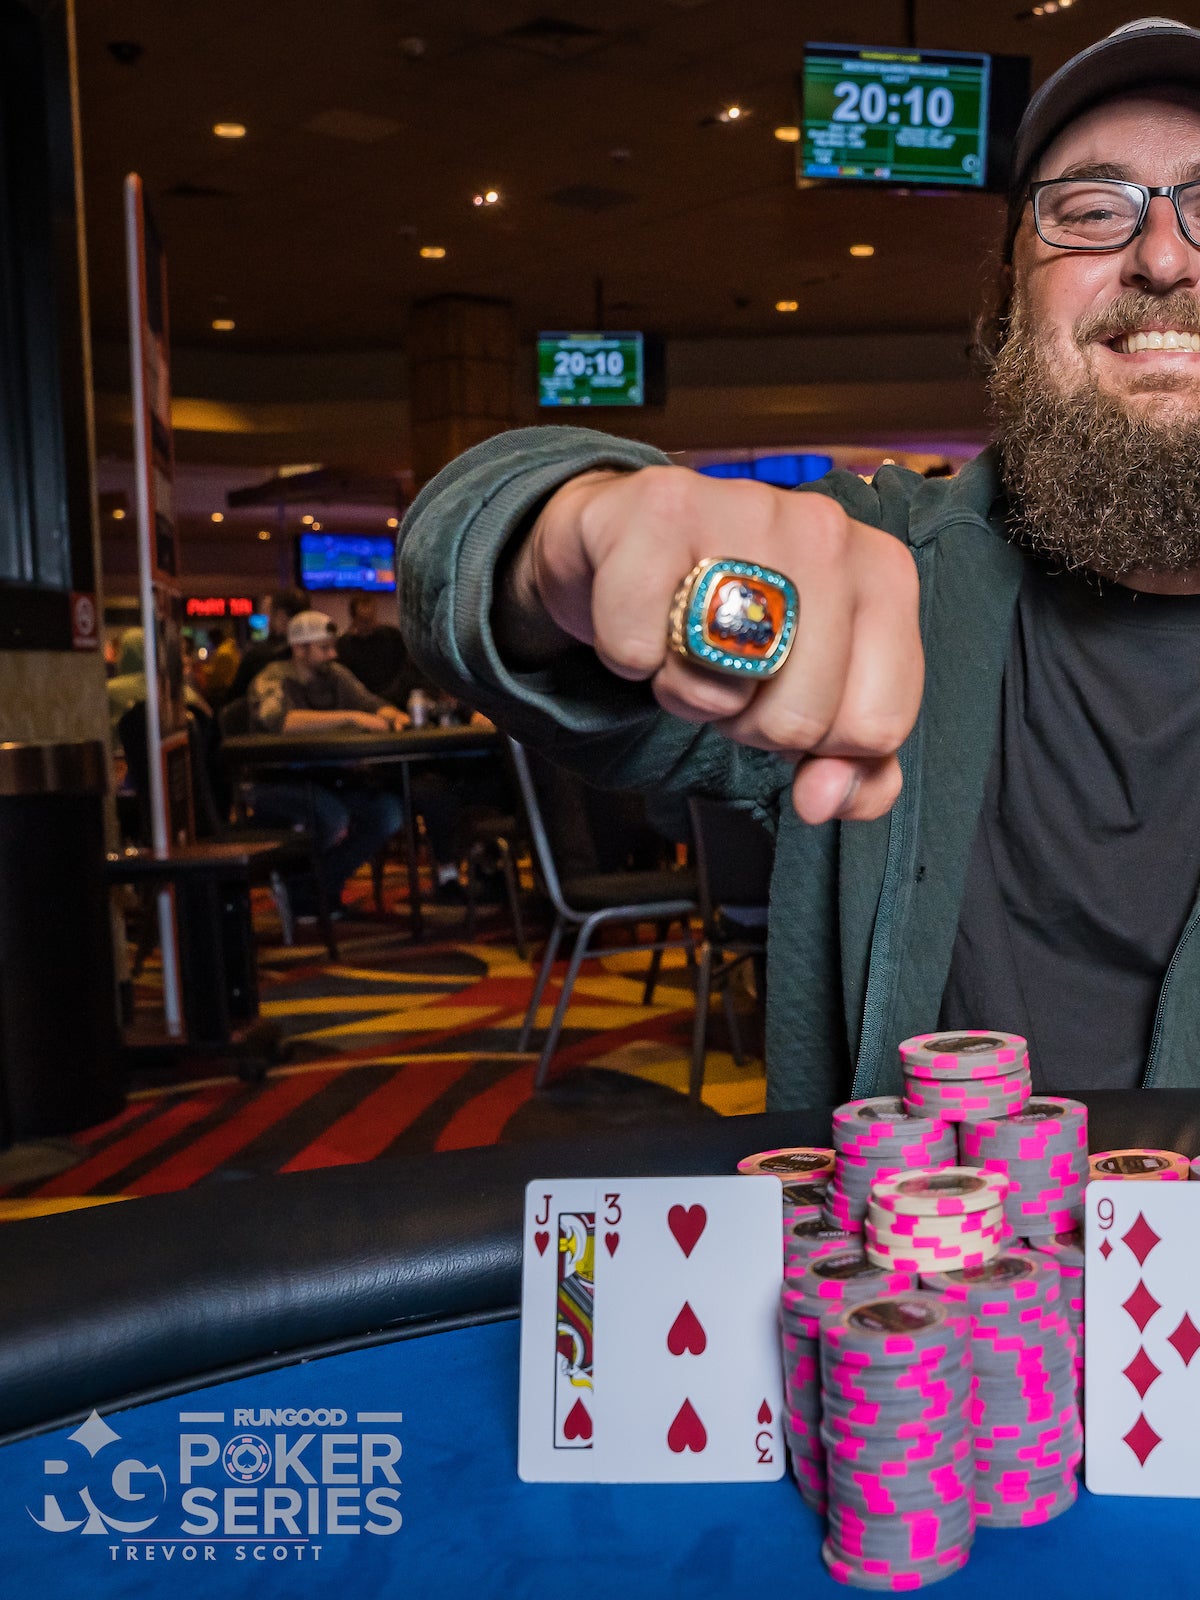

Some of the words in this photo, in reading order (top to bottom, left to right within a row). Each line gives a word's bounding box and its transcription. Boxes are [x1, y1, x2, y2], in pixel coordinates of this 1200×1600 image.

[832, 81, 955, 128] 20:10
[553, 351, 625, 376] 20:10
[535, 1195, 552, 1225] J
[604, 1194, 622, 1225] 3
[1097, 1198, 1115, 1230] 9
[755, 1431, 774, 1464] 3
